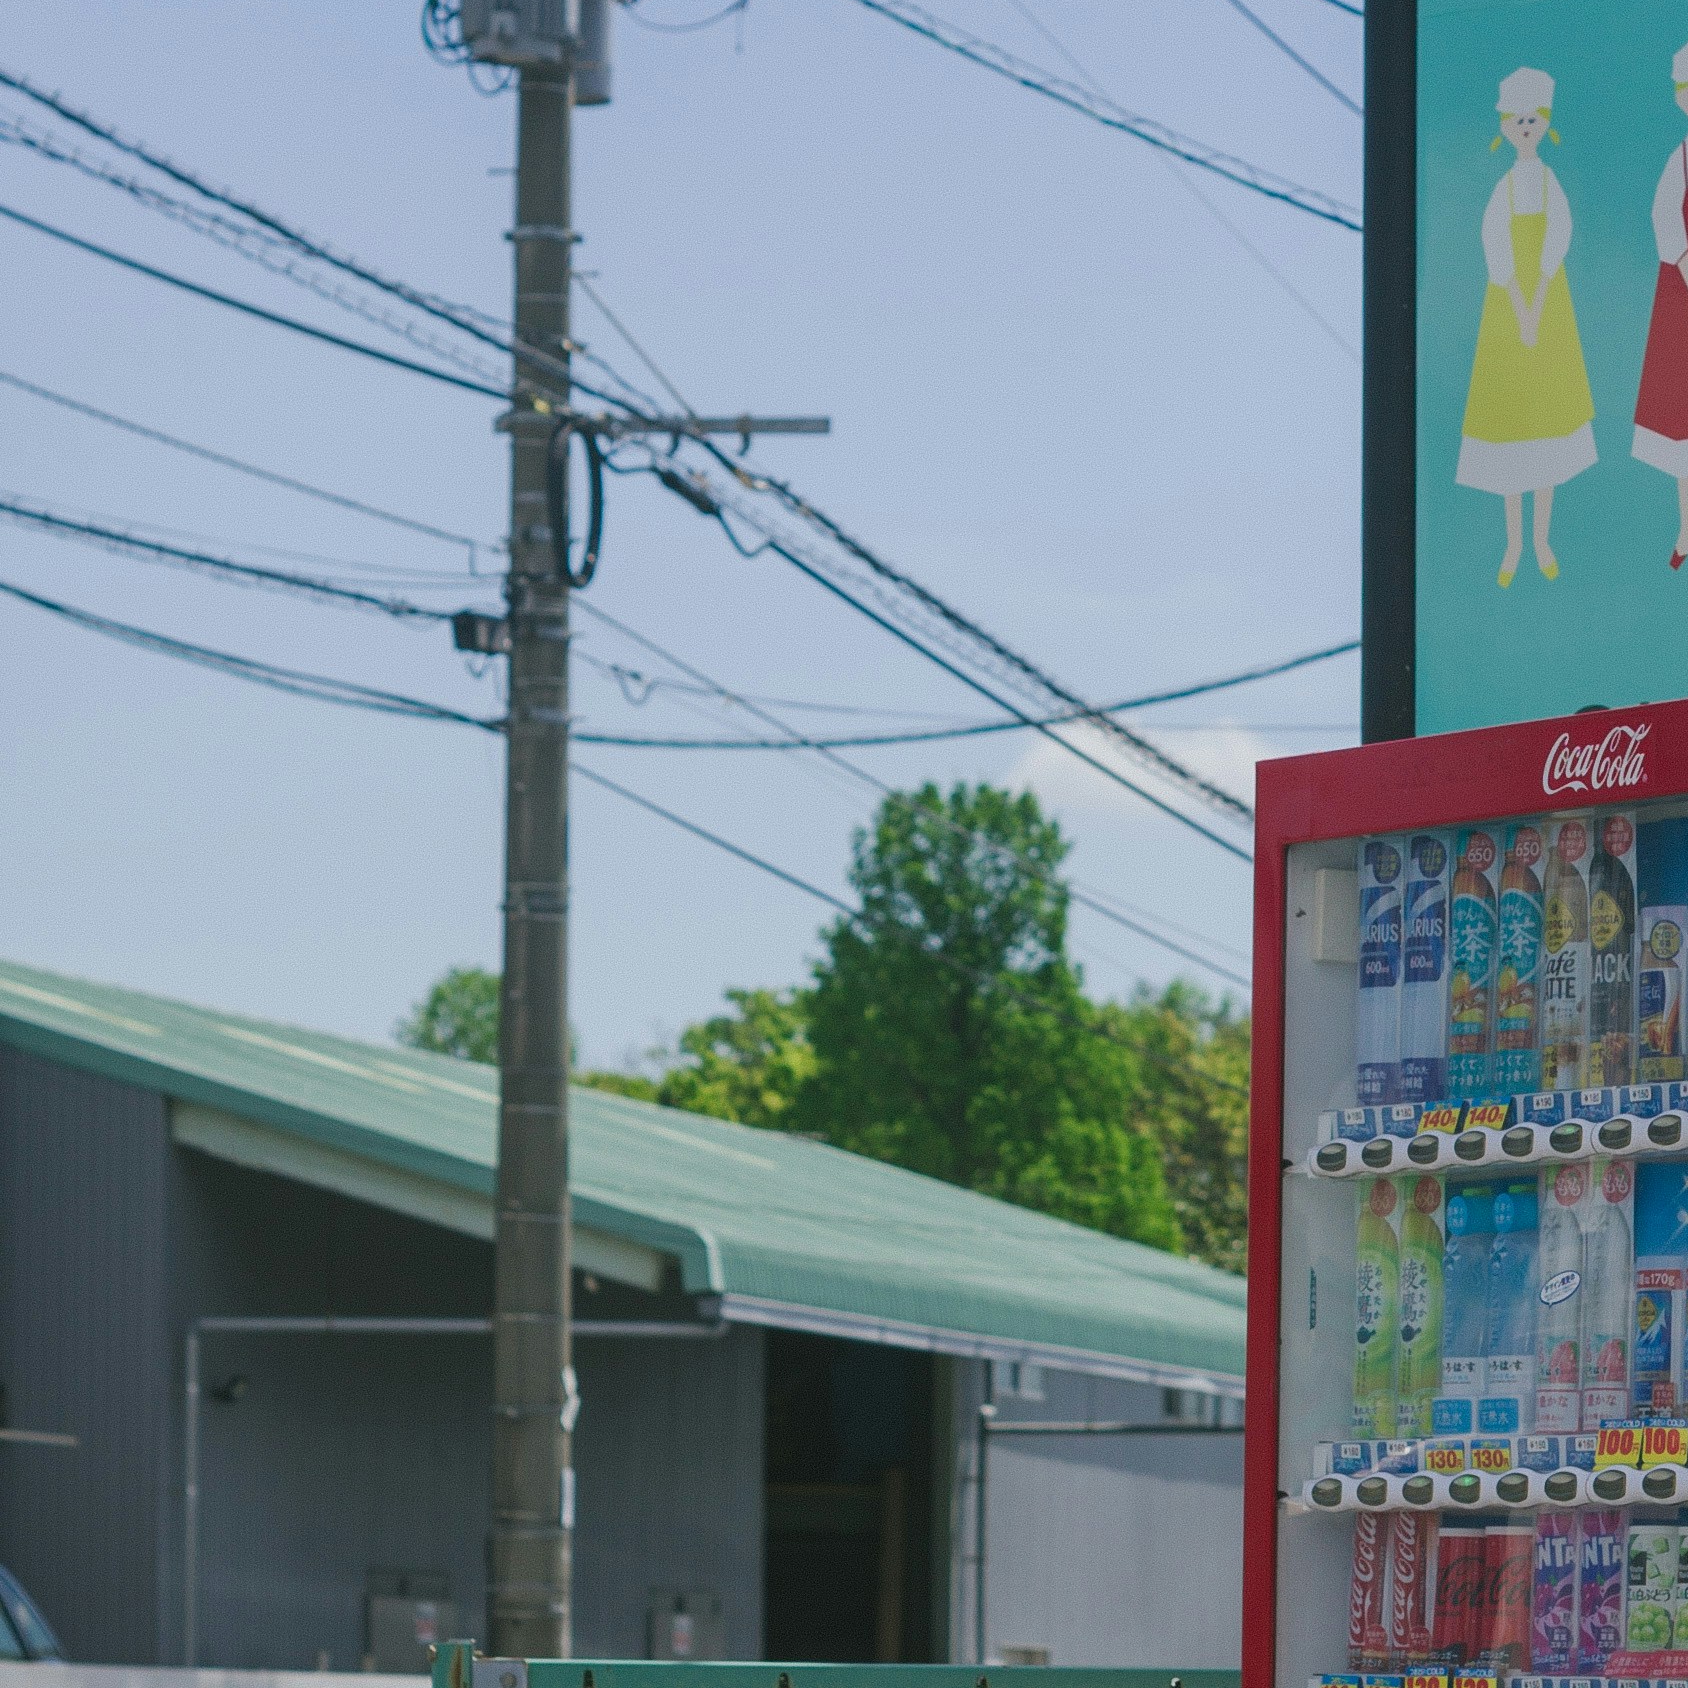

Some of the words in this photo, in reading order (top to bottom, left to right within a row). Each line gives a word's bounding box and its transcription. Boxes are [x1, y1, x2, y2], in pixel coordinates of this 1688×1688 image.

[1542, 723, 1653, 795] Coca-Cola
[1467, 847, 1493, 863] 650
[1515, 842, 1540, 857] 650
